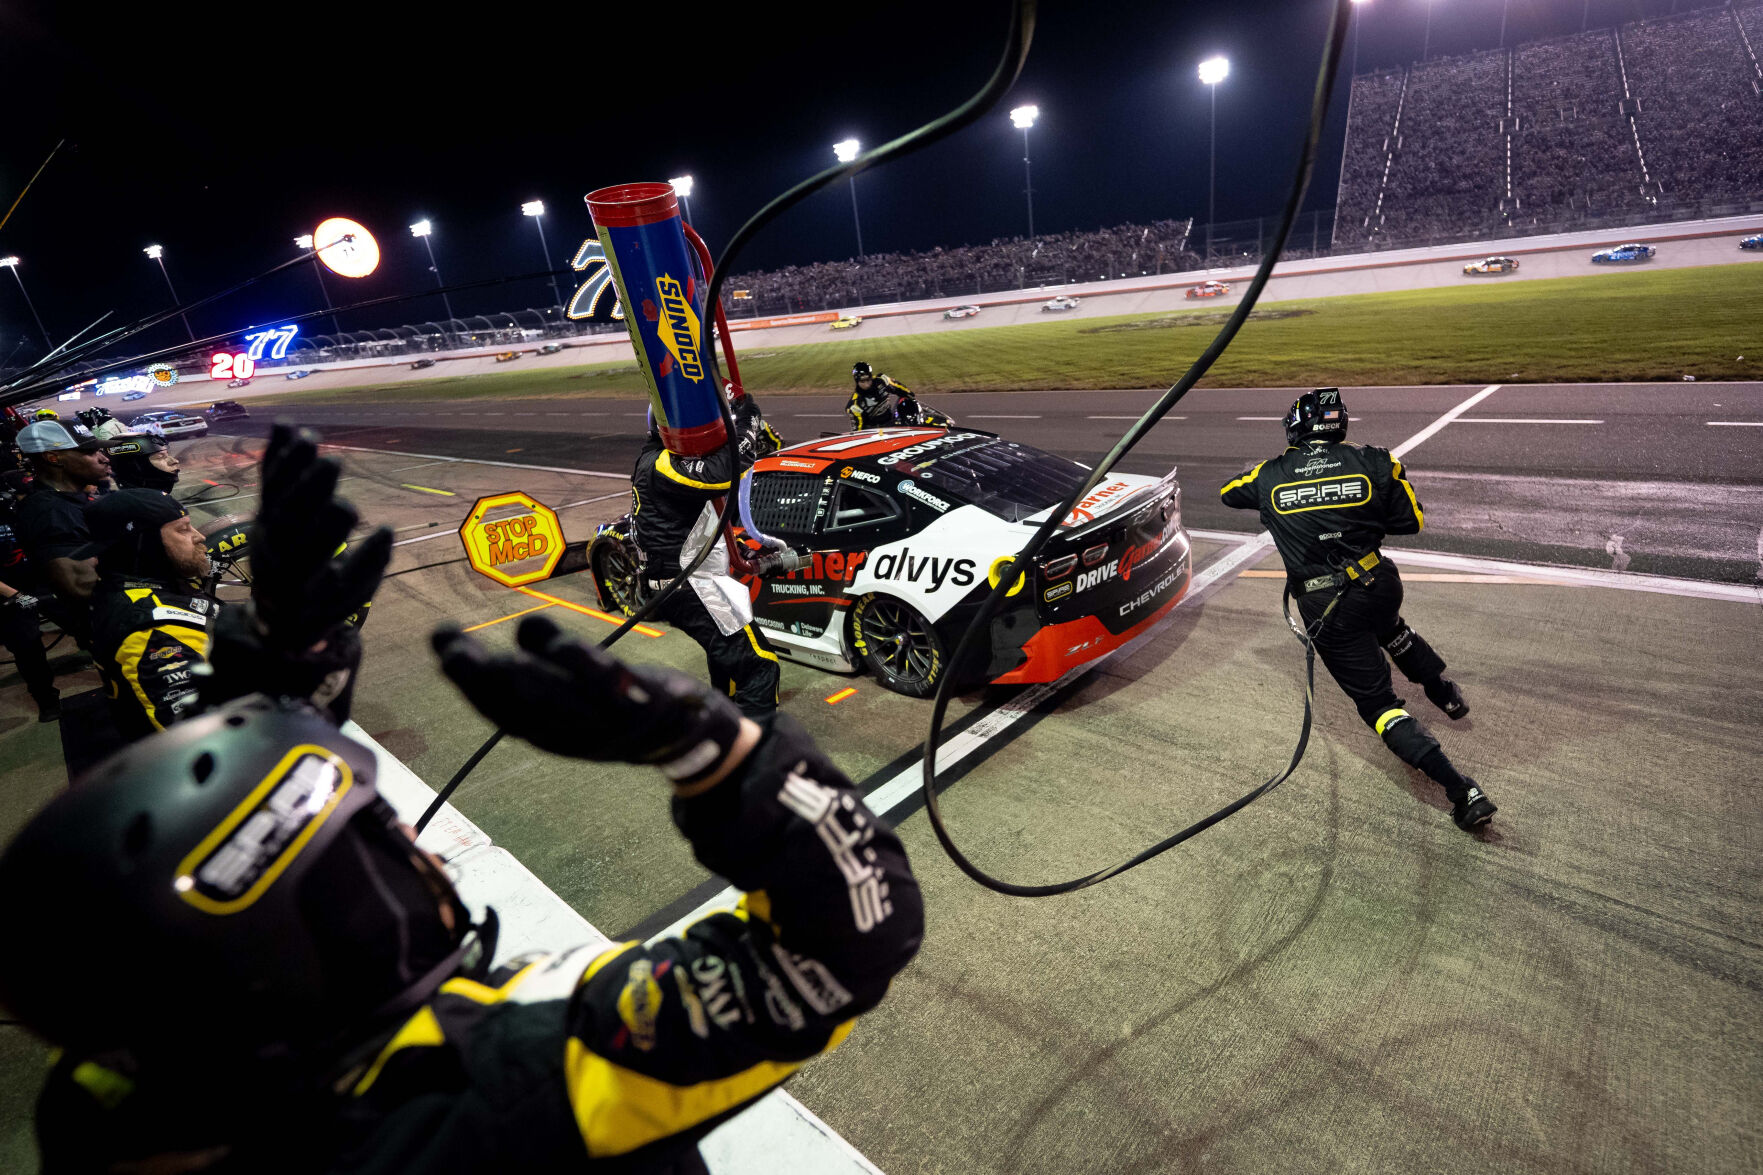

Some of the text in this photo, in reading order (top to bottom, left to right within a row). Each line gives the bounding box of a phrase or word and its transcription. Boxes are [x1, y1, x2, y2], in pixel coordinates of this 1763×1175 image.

[661, 279, 701, 377] SUNOCO
[245, 325, 298, 360] 77
[210, 353, 254, 379] 20
[1319, 391, 1338, 405] 71
[1312, 422, 1341, 431] BOECK
[851, 468, 881, 484] NEFCO
[903, 482, 951, 511] WORKFORCE
[1279, 481, 1362, 503] SPIRE
[1280, 493, 1362, 508] MOTORSPORTS
[484, 515, 538, 544] STOP
[488, 533, 548, 567] McD
[874, 547, 977, 594] alvys
[771, 583, 825, 595] TRUCKING, INC.
[1119, 562, 1186, 617] CHEVROLET
[800, 622, 824, 633] Delaware
[809, 653, 837, 664] respect
[928, 648, 940, 685] EAGLE
